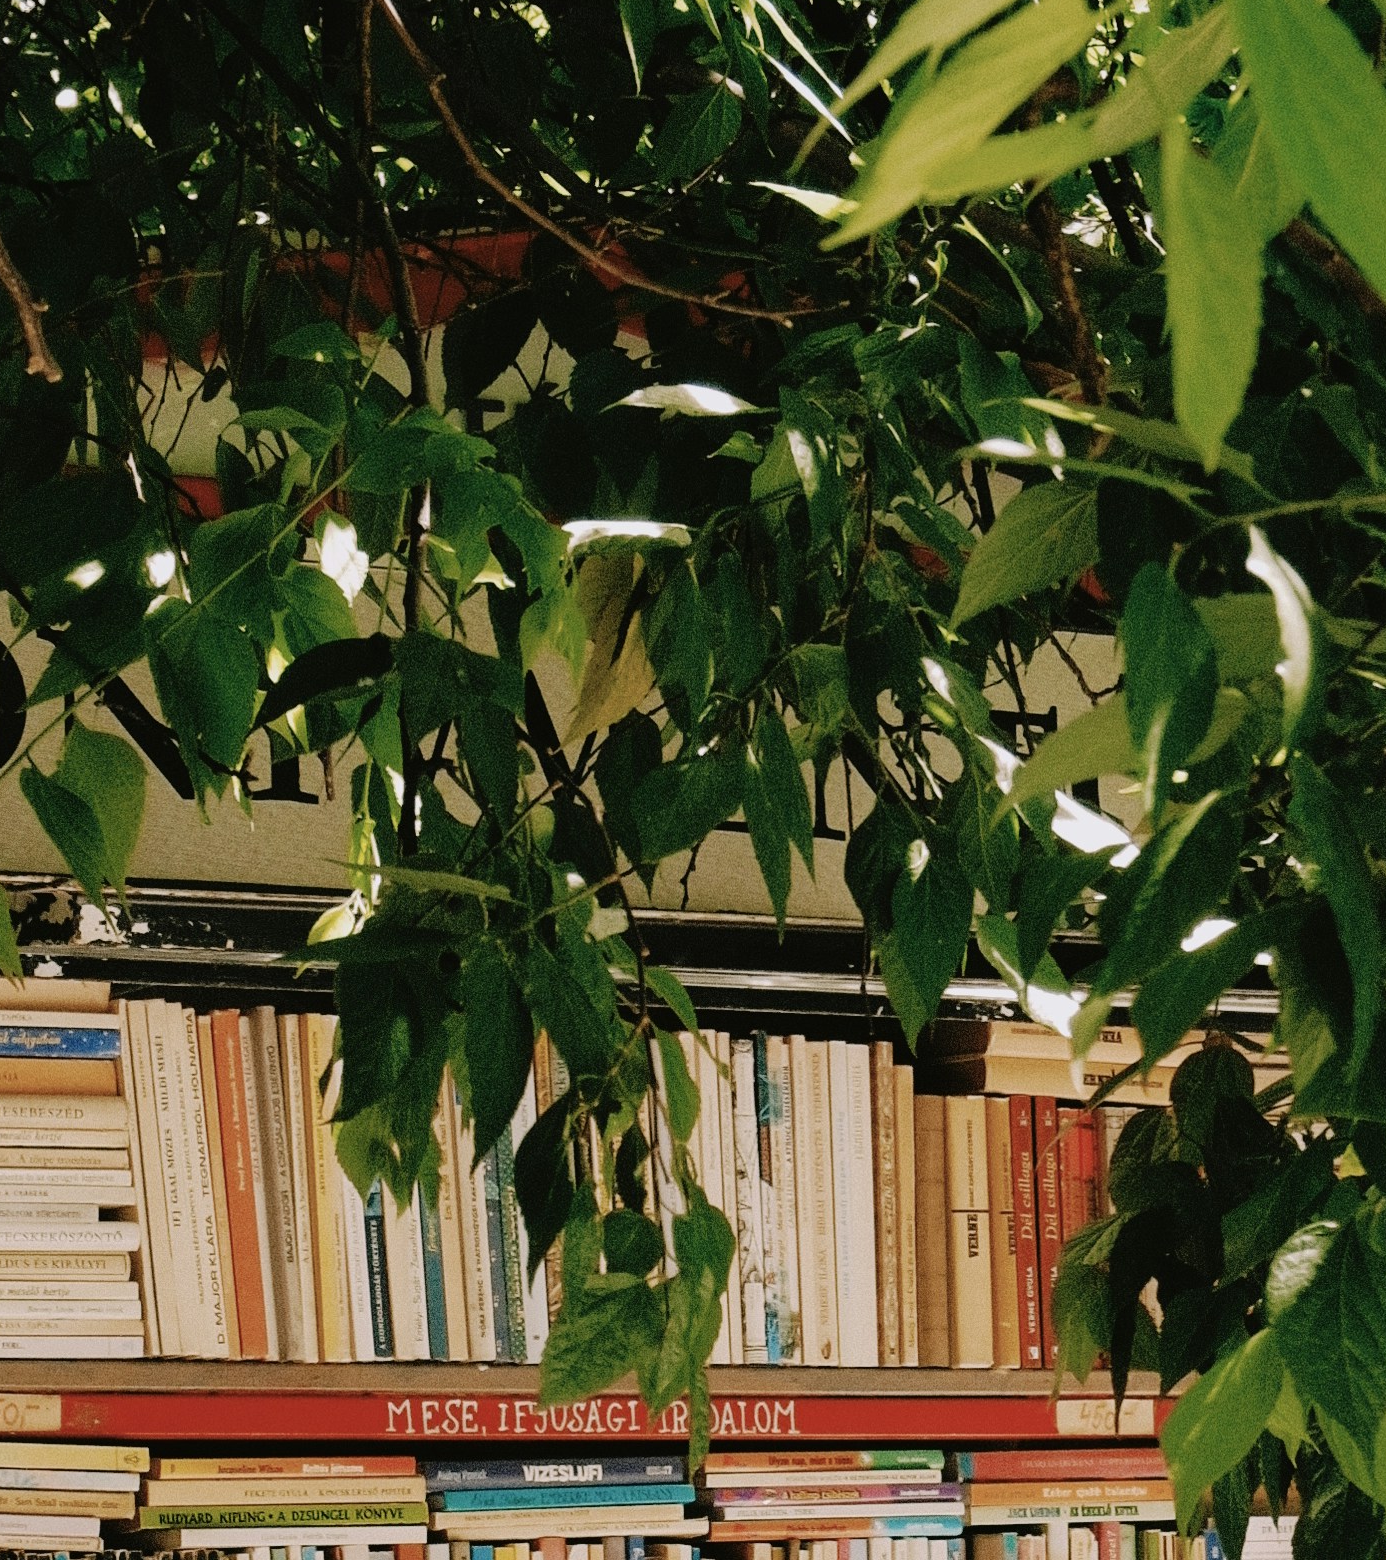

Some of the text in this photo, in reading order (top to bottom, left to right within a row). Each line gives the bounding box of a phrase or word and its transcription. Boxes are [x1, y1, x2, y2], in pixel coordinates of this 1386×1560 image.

[184, 1013, 201, 1099] HOLNAPRA
[193, 1105, 210, 1197] TEGNAPRÓL
[1042, 1152, 1057, 1240] Dél csillaga
[966, 1213, 979, 1257] VERNE
[1017, 1152, 1036, 1334] VERNE GYULA Dél csillaga
[209, 1269, 223, 1326] MAJOR
[386, 1398, 487, 1437] MESE,
[657, 1399, 801, 1435] IRDALOM
[523, 1464, 604, 1482] VIZESLUFI
[159, 1505, 404, 1525] RUDYARD KIPLING A DZSUNGEL KÖNYVE
